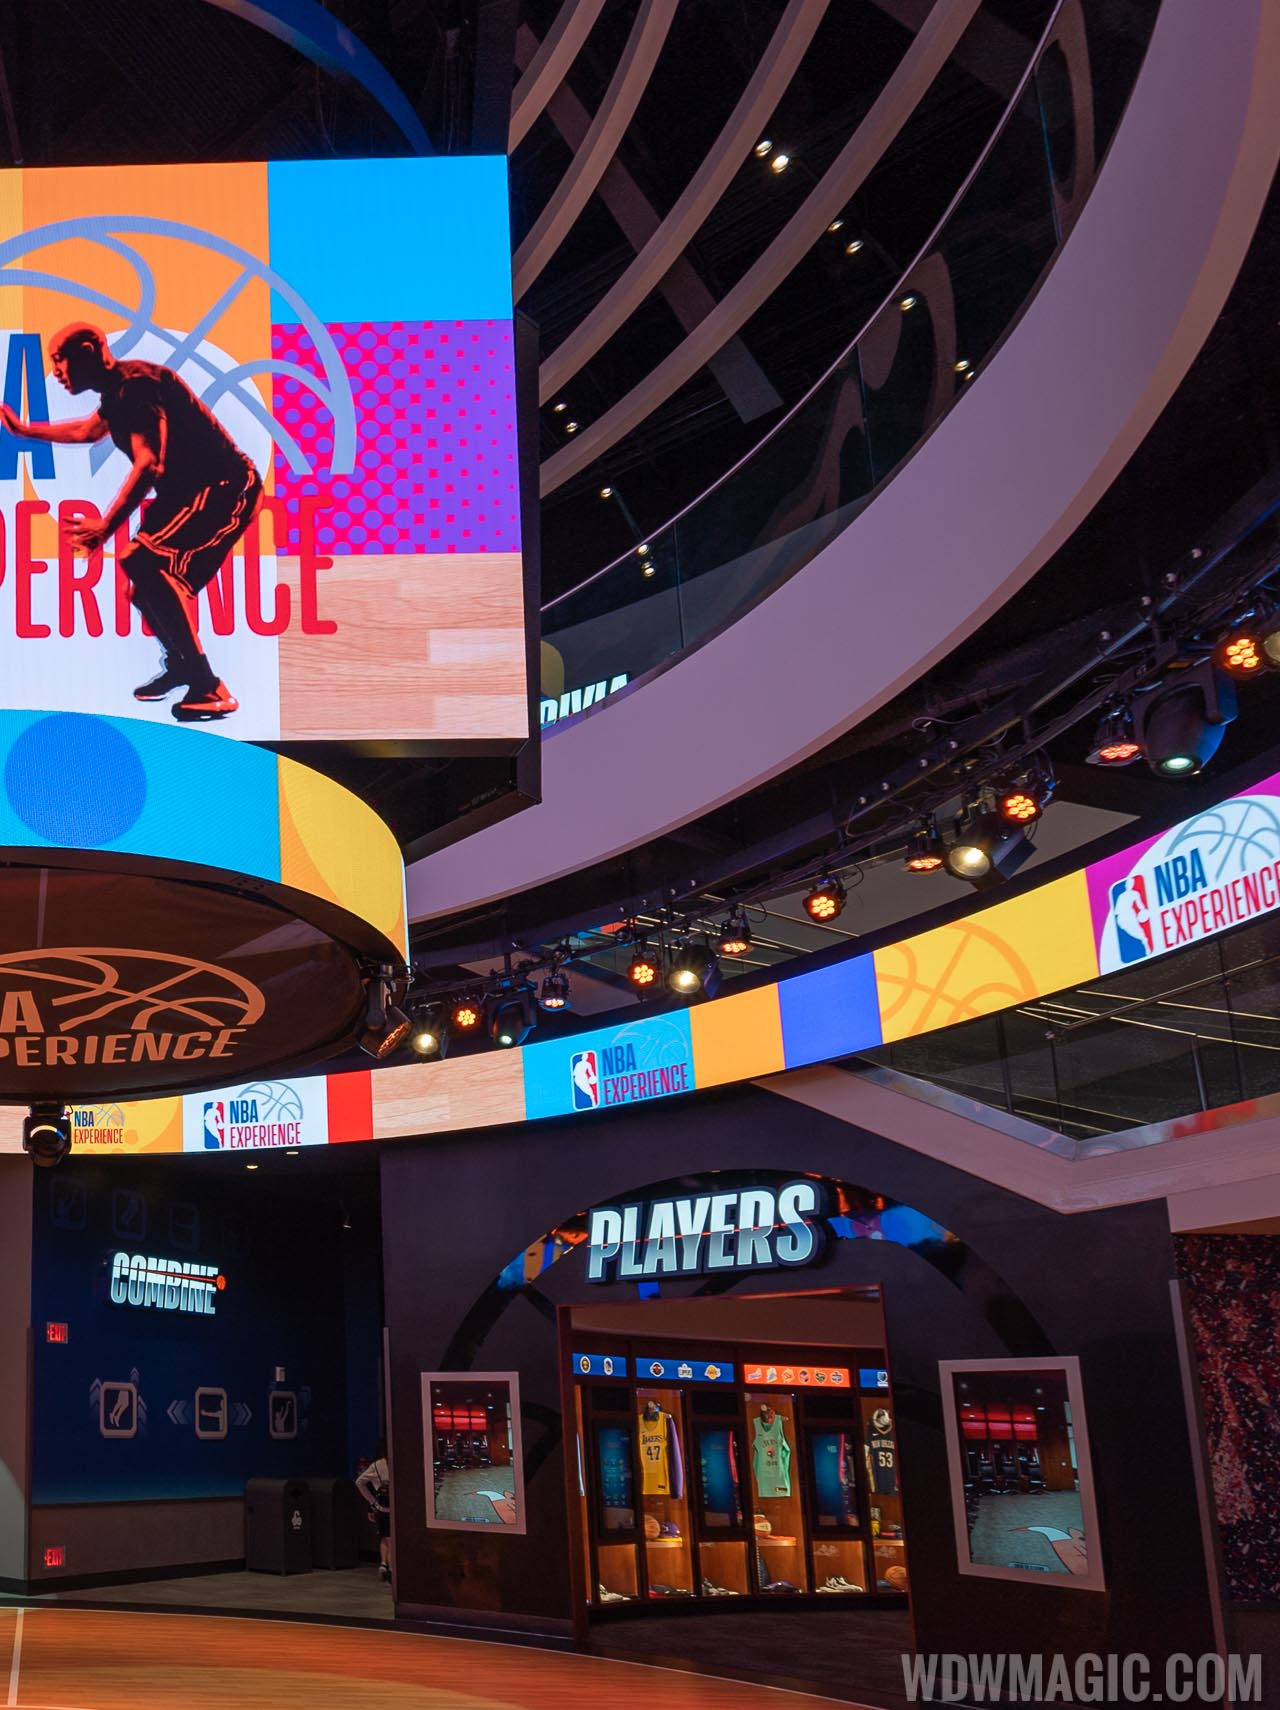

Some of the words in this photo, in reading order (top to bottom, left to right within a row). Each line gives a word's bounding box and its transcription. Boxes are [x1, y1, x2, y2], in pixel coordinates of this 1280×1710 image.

[1154, 848, 1208, 906] NBA
[602, 1043, 636, 1076] NBA
[603, 1063, 689, 1105] EXPERIENCE
[74, 1110, 94, 1127] NBA
[229, 1100, 259, 1124] NBA
[73, 1128, 123, 1144] EXPERIENCE
[230, 1122, 302, 1148] EXPERIENCE
[588, 1184, 815, 1278] PLAYERS
[110, 1252, 219, 1315] COMBINE
[48, 1322, 66, 1342] EXIT
[646, 1446, 661, 1462] 47
[877, 1451, 894, 1469] 53
[46, 1548, 63, 1566] EXIT
